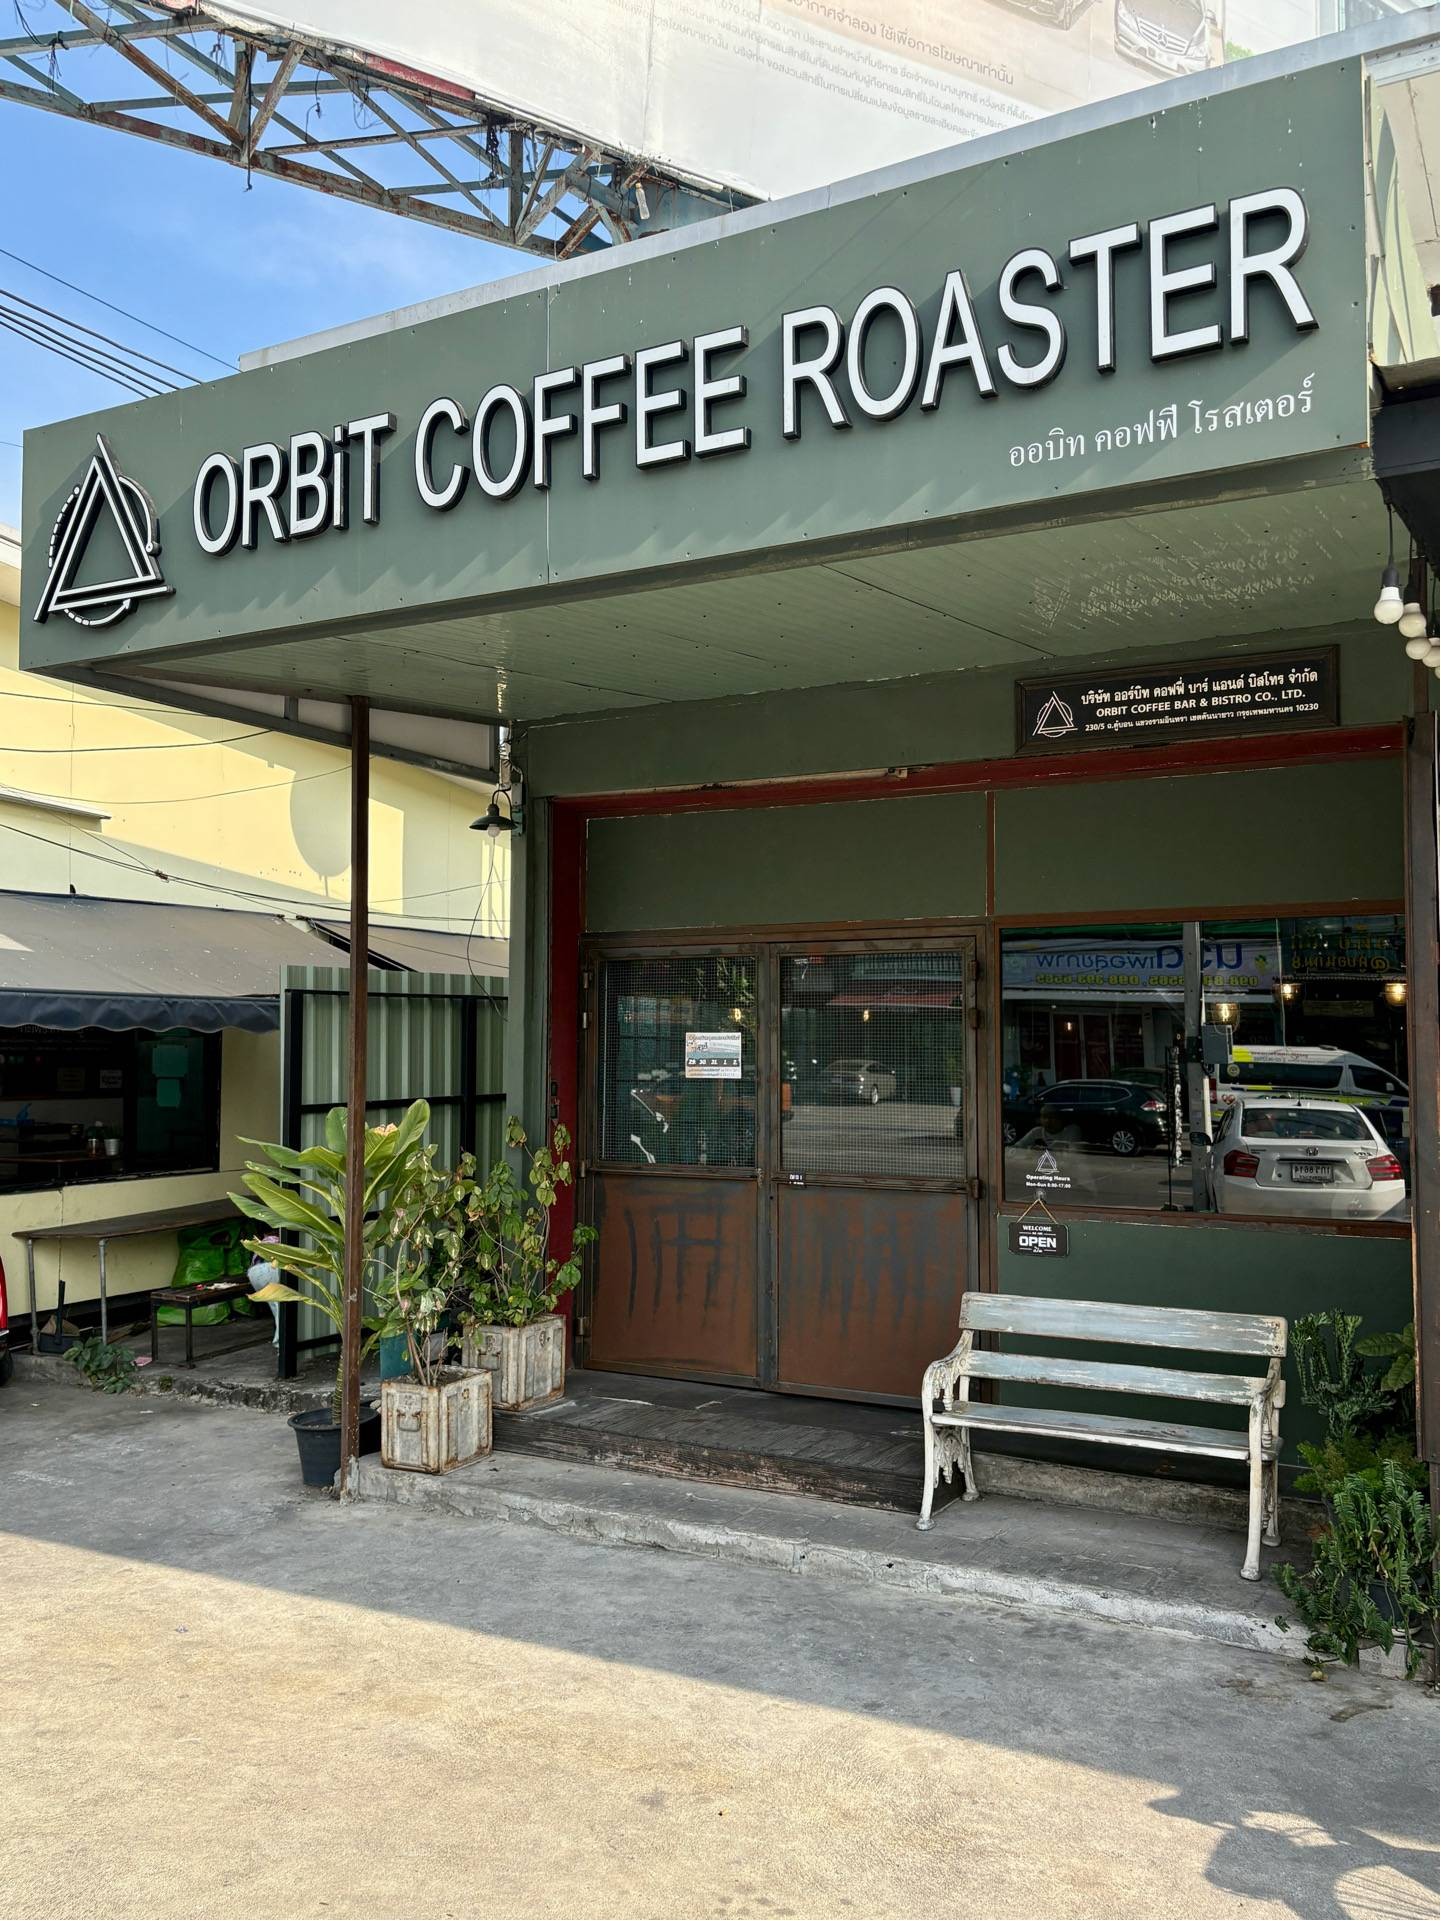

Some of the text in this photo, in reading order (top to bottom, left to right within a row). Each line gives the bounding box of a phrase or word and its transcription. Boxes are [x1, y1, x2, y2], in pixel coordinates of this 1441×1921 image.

[414, 326, 750, 512] COFFEE
[781, 186, 1319, 440] ROASTER
[1009, 373, 1315, 467] ออบิท คอฟฟี โรสเตอร์
[1081, 667, 1318, 705] บริษัท ออร์บิท คอฟฟี่ บาร์ แอนด์ บิสโทร จำกัด
[1085, 722, 1105, 731] 230/5
[1296, 703, 1319, 711] 10230
[1096, 689, 1306, 717] ORBIT COFFEE BAR & BISTRO CO., LTD.
[1019, 1235, 1057, 1248] OPEN
